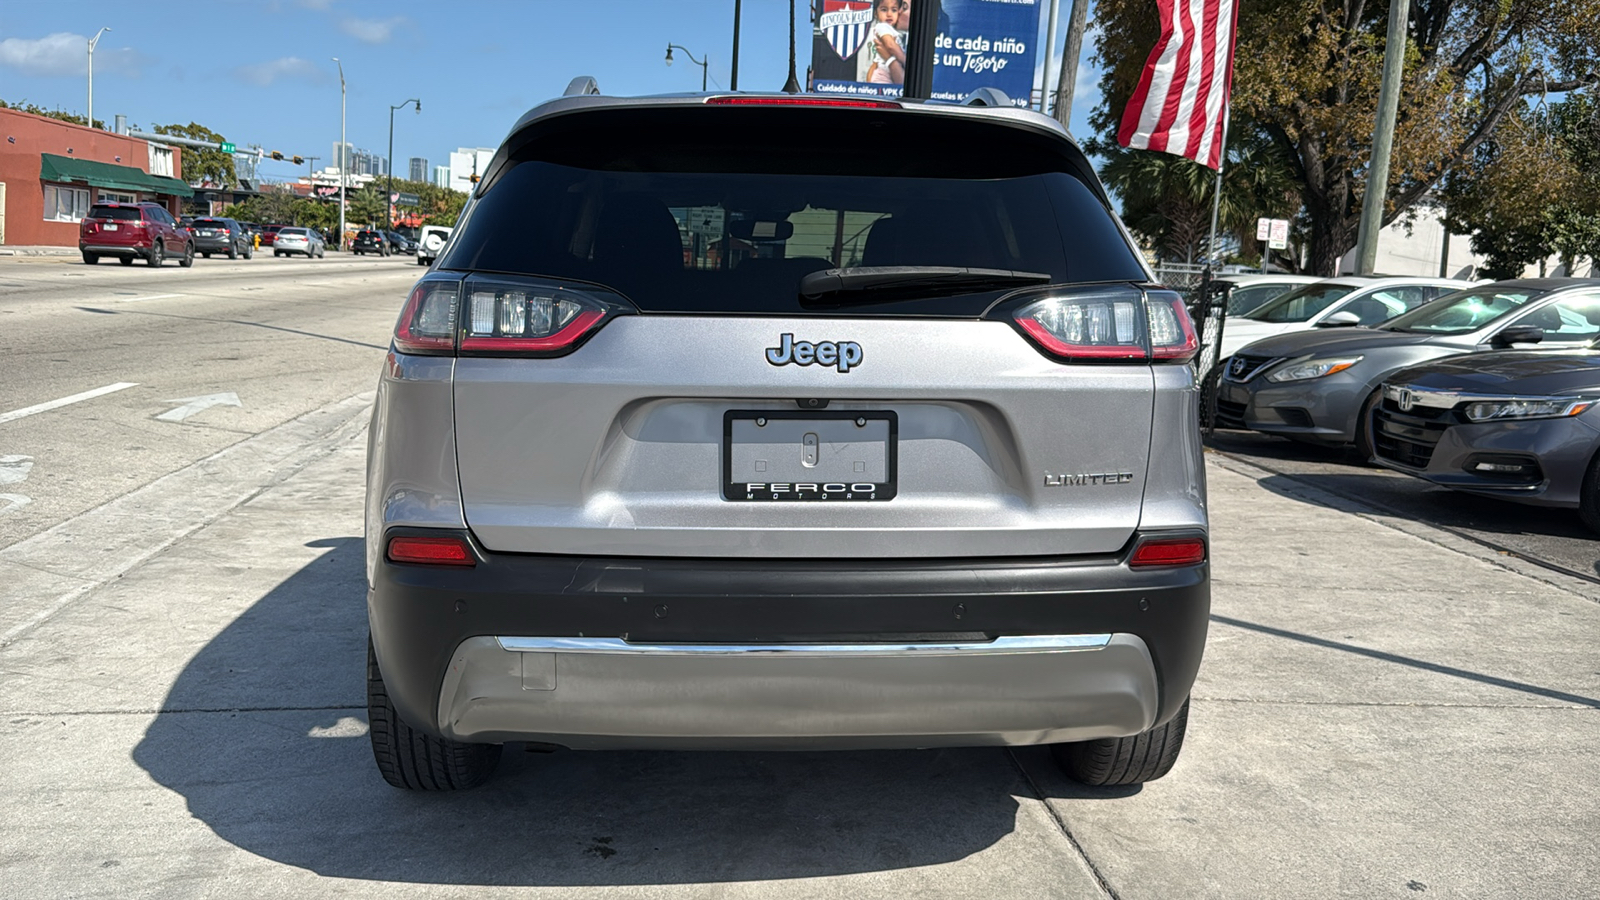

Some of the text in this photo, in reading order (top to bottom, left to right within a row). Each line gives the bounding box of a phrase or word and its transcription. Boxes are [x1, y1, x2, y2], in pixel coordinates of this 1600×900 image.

[934, 33, 1026, 54] de cada niño
[943, 54, 962, 67] un
[963, 52, 1008, 73] Tesoro
[817, 83, 846, 93] Cuidado
[847, 85, 856, 93] de
[858, 86, 878, 96] niños
[882, 88, 899, 97] VPK
[765, 333, 863, 373] Jeep
[747, 483, 876, 492] FERCO
[1044, 473, 1133, 487] LIMITED
